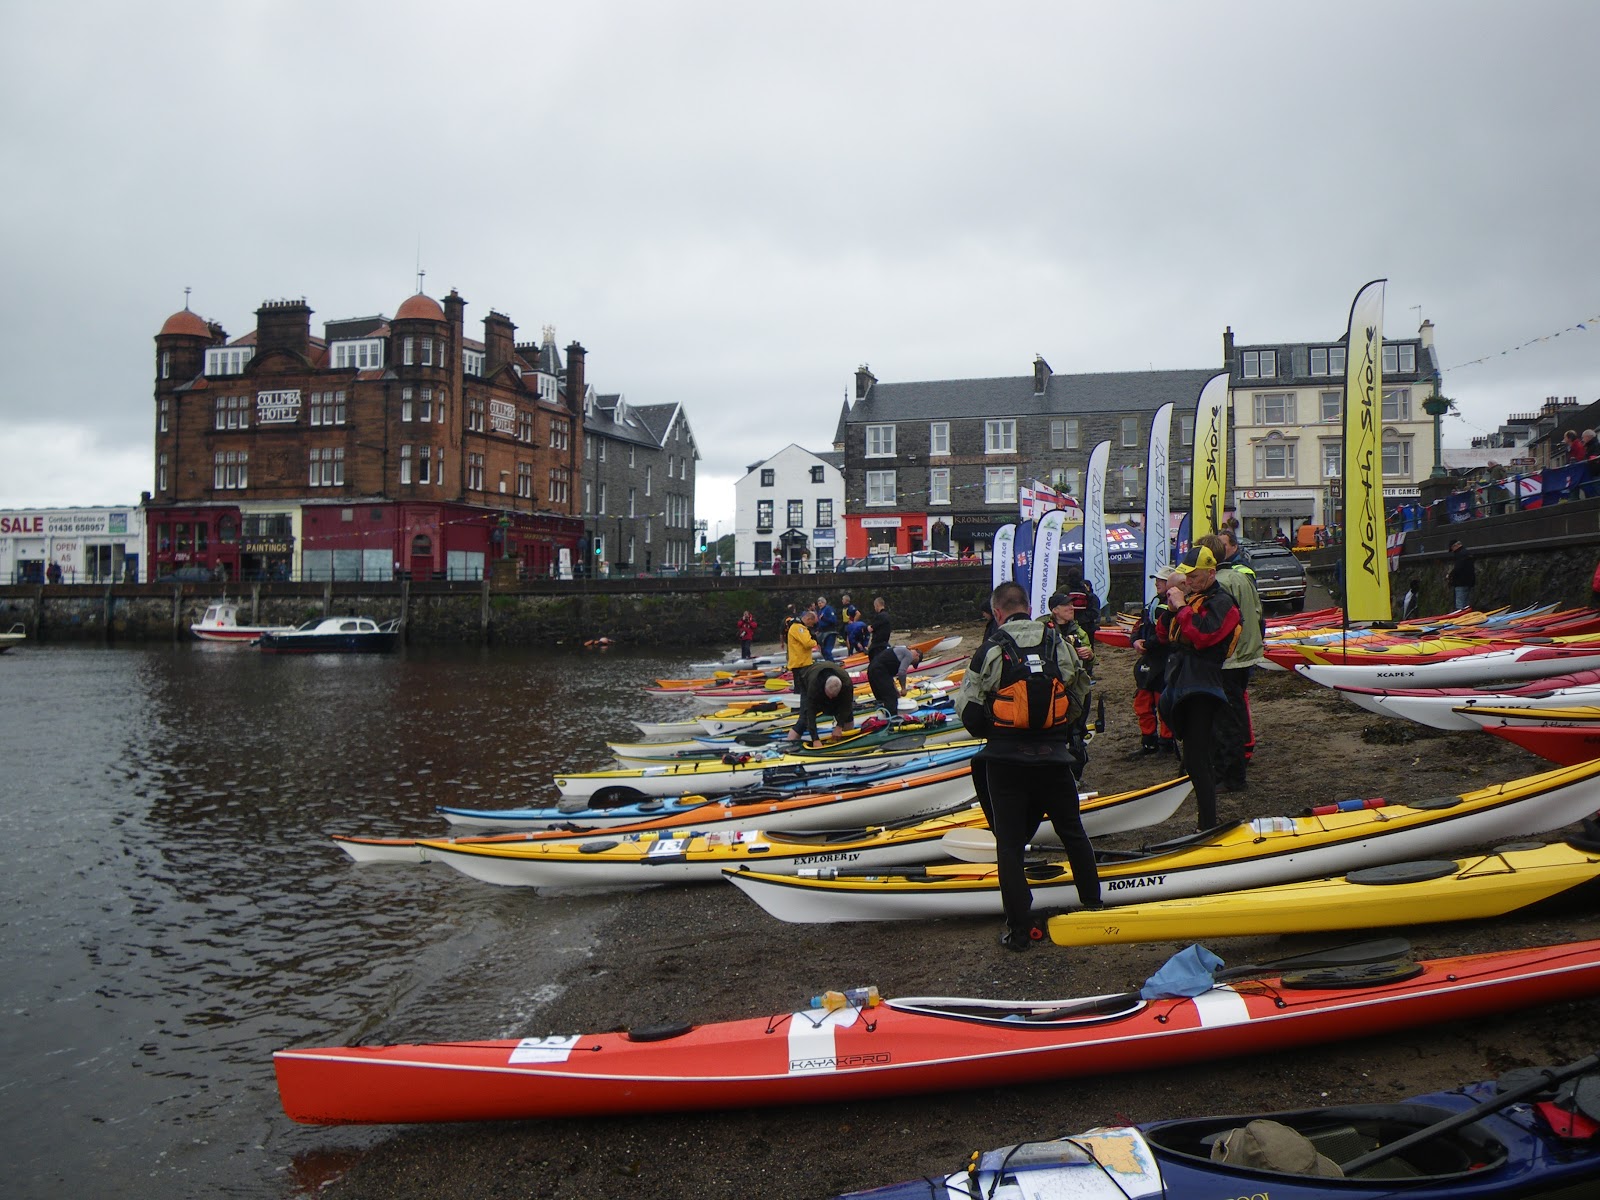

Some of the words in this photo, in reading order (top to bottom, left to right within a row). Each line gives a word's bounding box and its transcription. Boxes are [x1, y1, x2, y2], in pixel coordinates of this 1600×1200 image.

[1360, 325, 1375, 432] Shore
[257, 392, 302, 406] COLUMBA
[261, 407, 297, 420] HOTEL
[1206, 404, 1220, 482] Shore
[1243, 490, 1269, 499] room
[48, 515, 73, 523] Contact
[1360, 450, 1376, 576] North
[1, 516, 44, 534] SALE
[954, 516, 991, 524] KRONKS
[1091, 470, 1106, 593] VALLEY
[56, 543, 77, 551] OPEN
[246, 543, 287, 553] PAINTINGS
[61, 554, 72, 562] AS
[793, 853, 848, 866] EXPLORER
[848, 853, 861, 862] LV
[1107, 875, 1167, 891] ROMANY
[791, 1054, 890, 1070] KAYAKPRO
